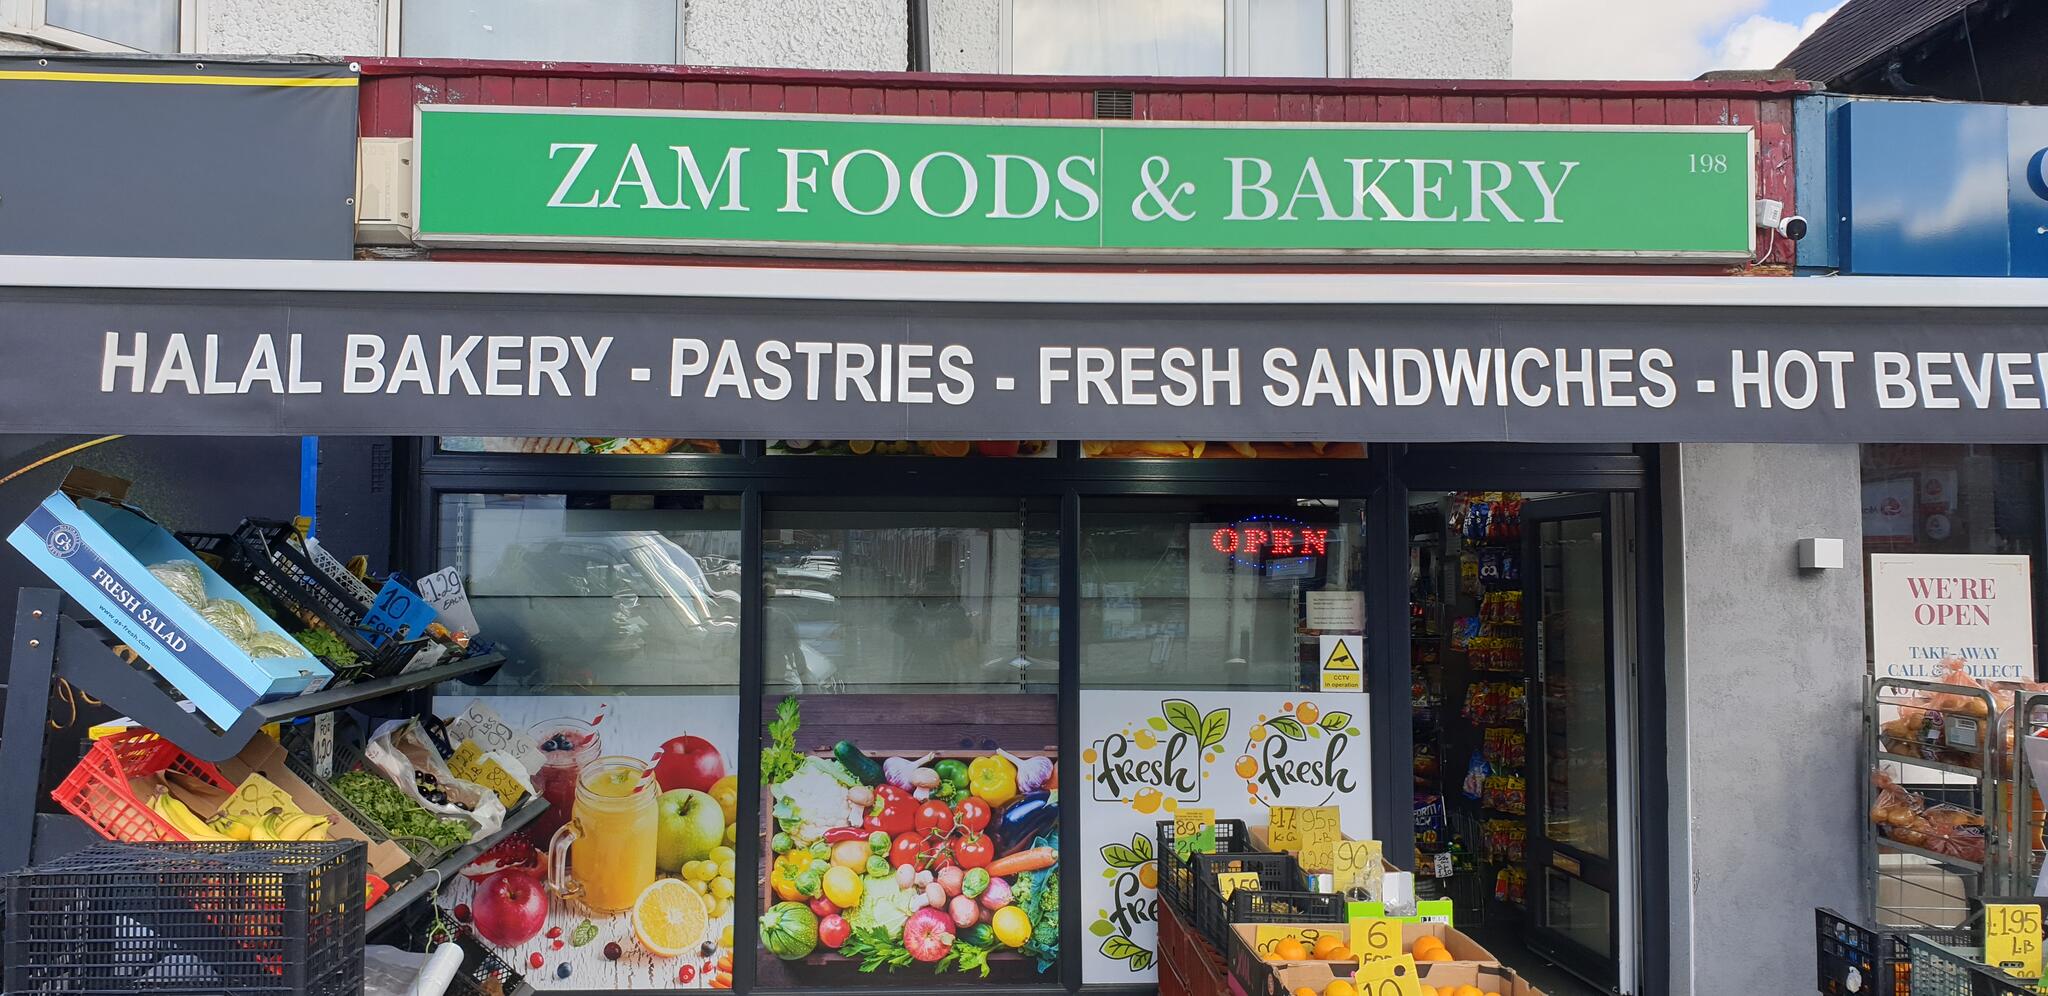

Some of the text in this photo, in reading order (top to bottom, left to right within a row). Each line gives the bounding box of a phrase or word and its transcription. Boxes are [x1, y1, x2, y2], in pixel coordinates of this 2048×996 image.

[1688, 153, 1728, 174] 198
[546, 143, 1580, 224] ZAM FOODS & BAKERY
[102, 331, 322, 394] HALAL
[344, 334, 614, 397] BAKERY
[670, 338, 975, 405] PASTRIES
[1040, 346, 1241, 407] FRESH
[1262, 347, 1676, 409] SANDWICHES
[1732, 348, 1855, 410] HOT
[1874, 351, 2048, 409] BEVE
[1211, 527, 1328, 556] OPEN
[378, 587, 411, 620] 10
[1907, 577, 1996, 600] WE'RE
[91, 567, 187, 652] FRESH SALAD
[98, 605, 151, 651] www.gs-fresh.com
[1914, 603, 1992, 626] OPEN
[1888, 663, 1928, 677] CALL
[1962, 664, 2023, 678] OLLECT
[1097, 732, 1196, 798] fresh
[1258, 732, 1357, 799] fresh
[1110, 871, 1158, 938] fre
[1367, 920, 1389, 950] 6
